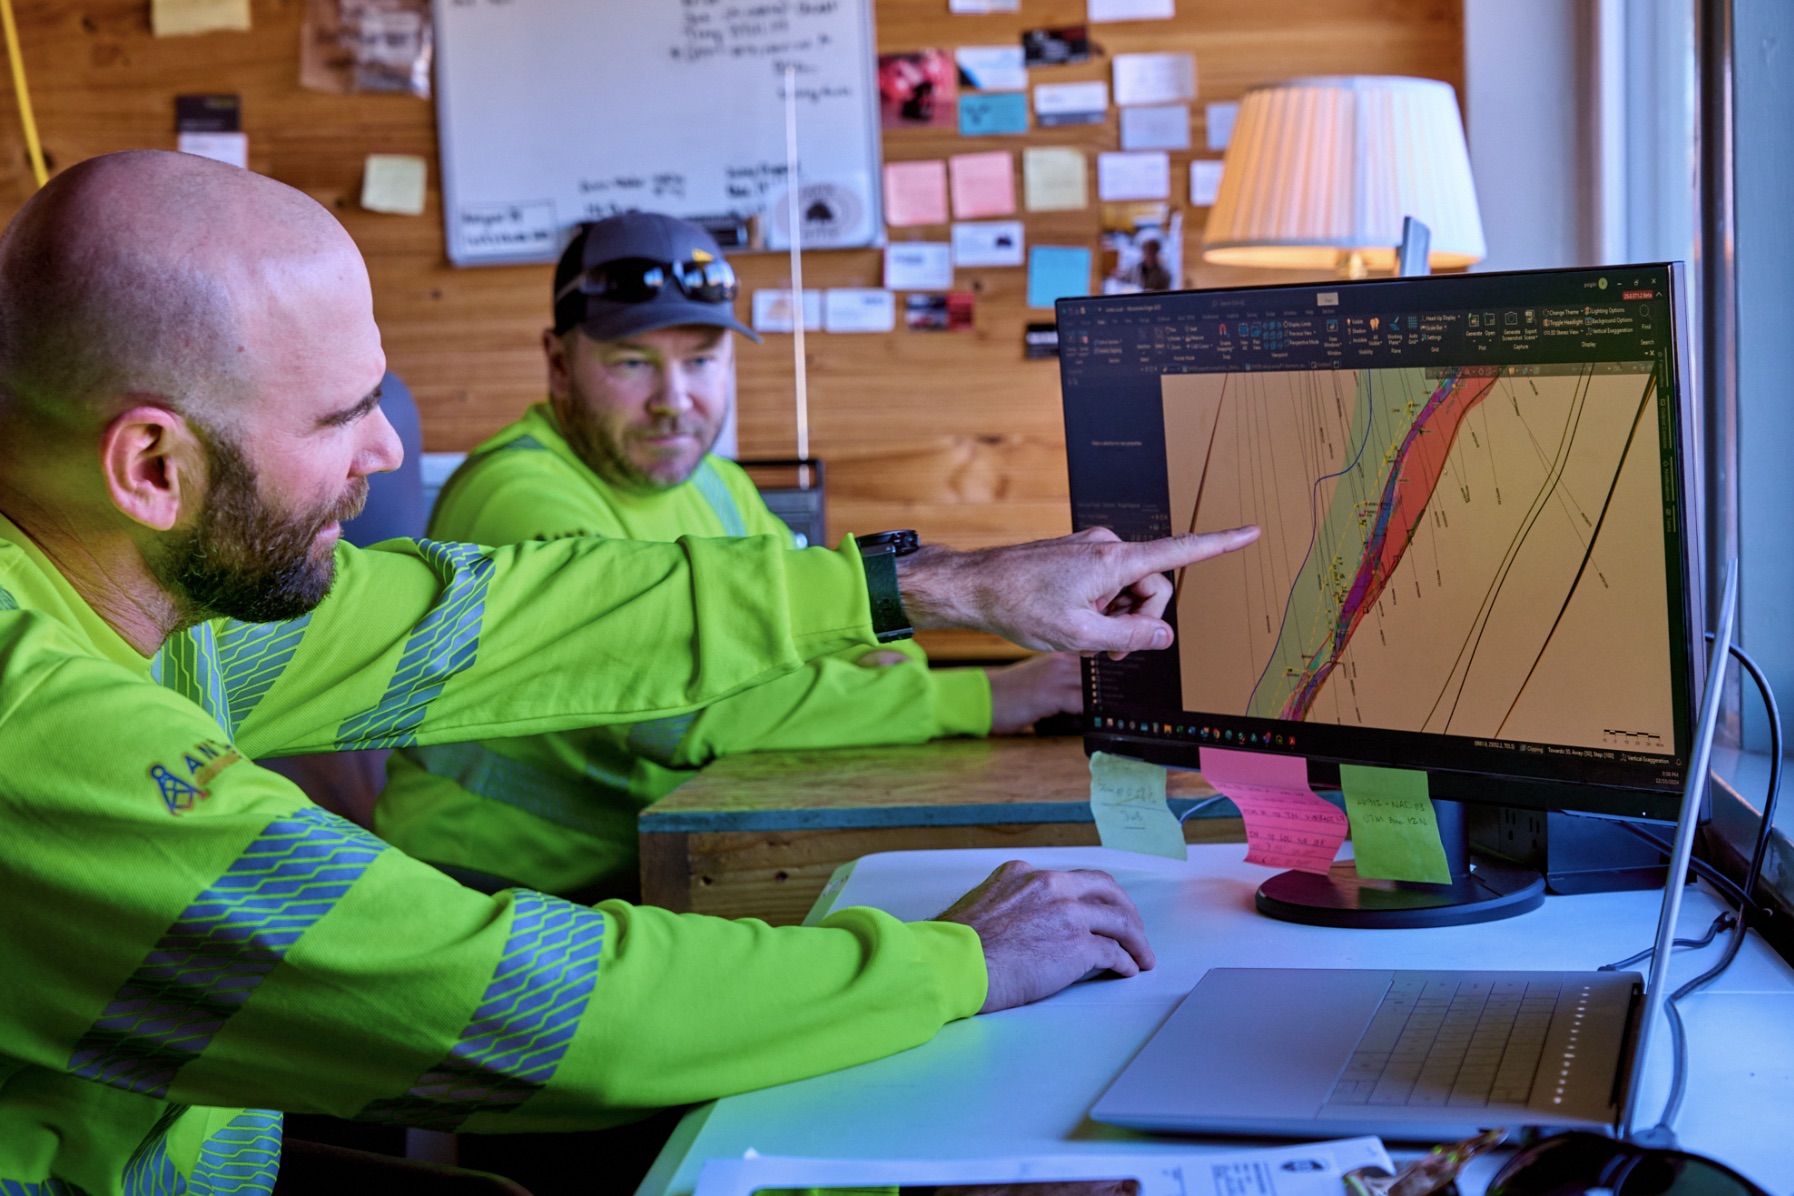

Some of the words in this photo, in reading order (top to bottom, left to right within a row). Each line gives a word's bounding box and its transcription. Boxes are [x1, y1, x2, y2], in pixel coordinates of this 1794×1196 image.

[1550, 309, 1564, 317] Change
[1609, 306, 1625, 314] Options
[1443, 314, 1456, 322] Display
[1593, 317, 1616, 325] Background
[1617, 316, 1633, 324] Options
[1550, 319, 1564, 327] Toggle
[1565, 318, 1583, 326] Headlight
[1484, 330, 1495, 338] Open
[1608, 327, 1634, 336] Exaggeration
[1387, 333, 1402, 341] Working
[1581, 341, 1597, 349] Display
[1640, 338, 1654, 346] Search
[1513, 344, 1529, 352] Capture
[1527, 745, 1543, 754] Clipping
[1627, 754, 1642, 762] Vertical
[1643, 756, 1670, 765] Exaggeration
[1363, 814, 1384, 823] UTM
